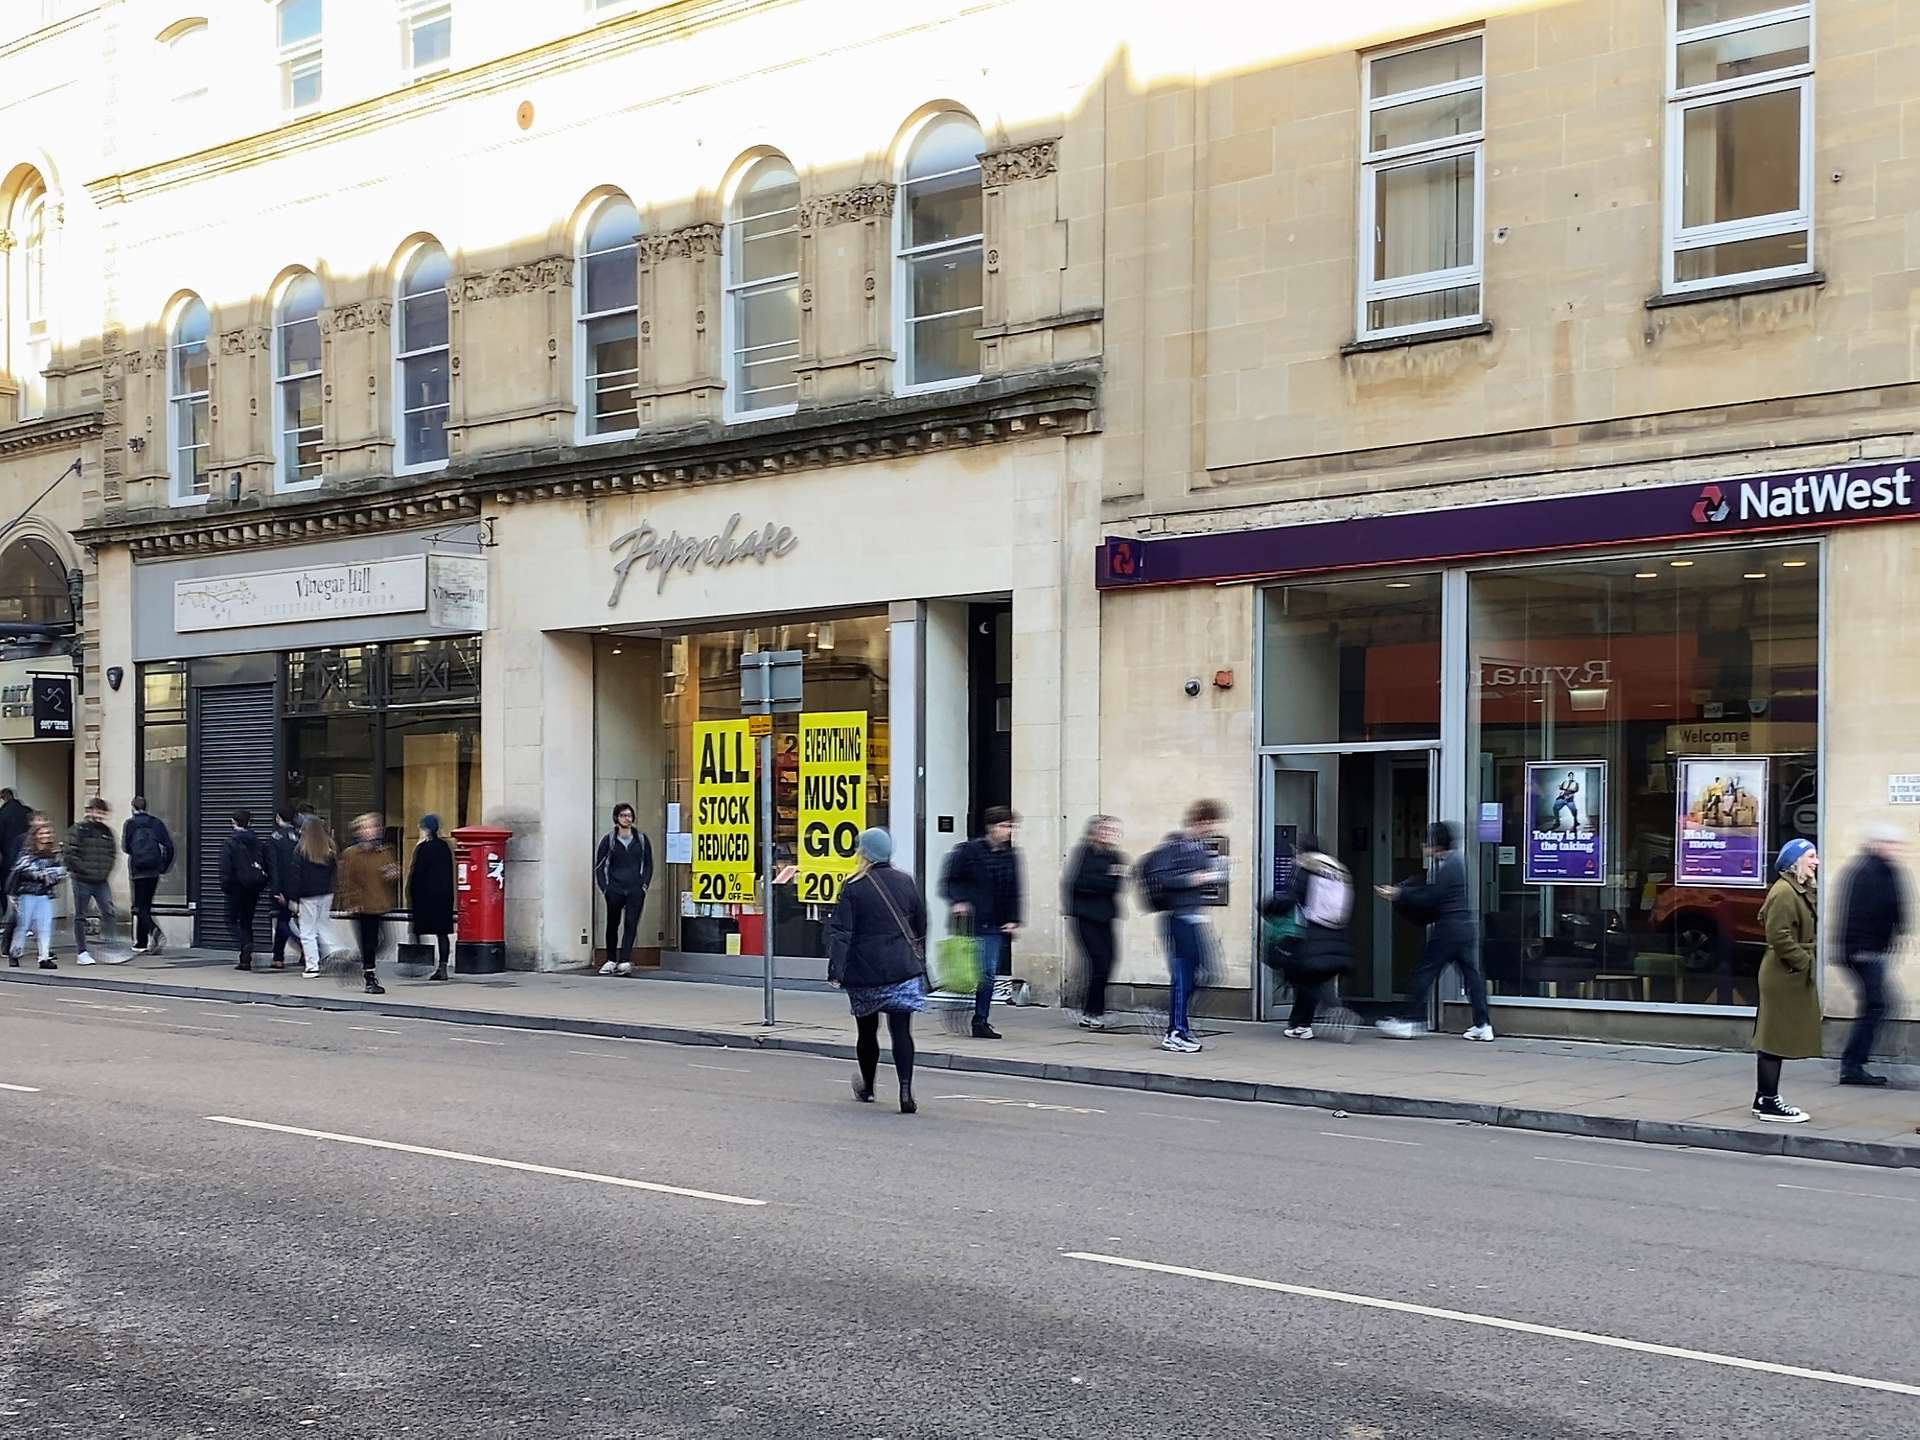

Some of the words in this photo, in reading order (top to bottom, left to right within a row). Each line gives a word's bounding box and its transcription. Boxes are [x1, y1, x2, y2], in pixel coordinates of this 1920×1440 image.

[1739, 466, 1912, 520] NatWest
[296, 573, 345, 600] Vinegar
[349, 567, 370, 593] Hill
[805, 727, 861, 762] EVERYTHING
[1680, 729, 1750, 743] Welcome
[699, 732, 749, 784] ALL
[804, 775, 861, 811] MUST
[698, 796, 750, 826] STOCK
[698, 833, 749, 862] REDUCED
[804, 821, 860, 858] GO
[1532, 830, 1564, 841] Today
[1566, 830, 1575, 840] is
[1577, 830, 1593, 840] for
[1541, 841, 1558, 851] the
[1559, 841, 1594, 854] taking
[1684, 829, 1716, 840] Make
[1689, 841, 1727, 850] moves
[728, 892, 742, 900] OFF
